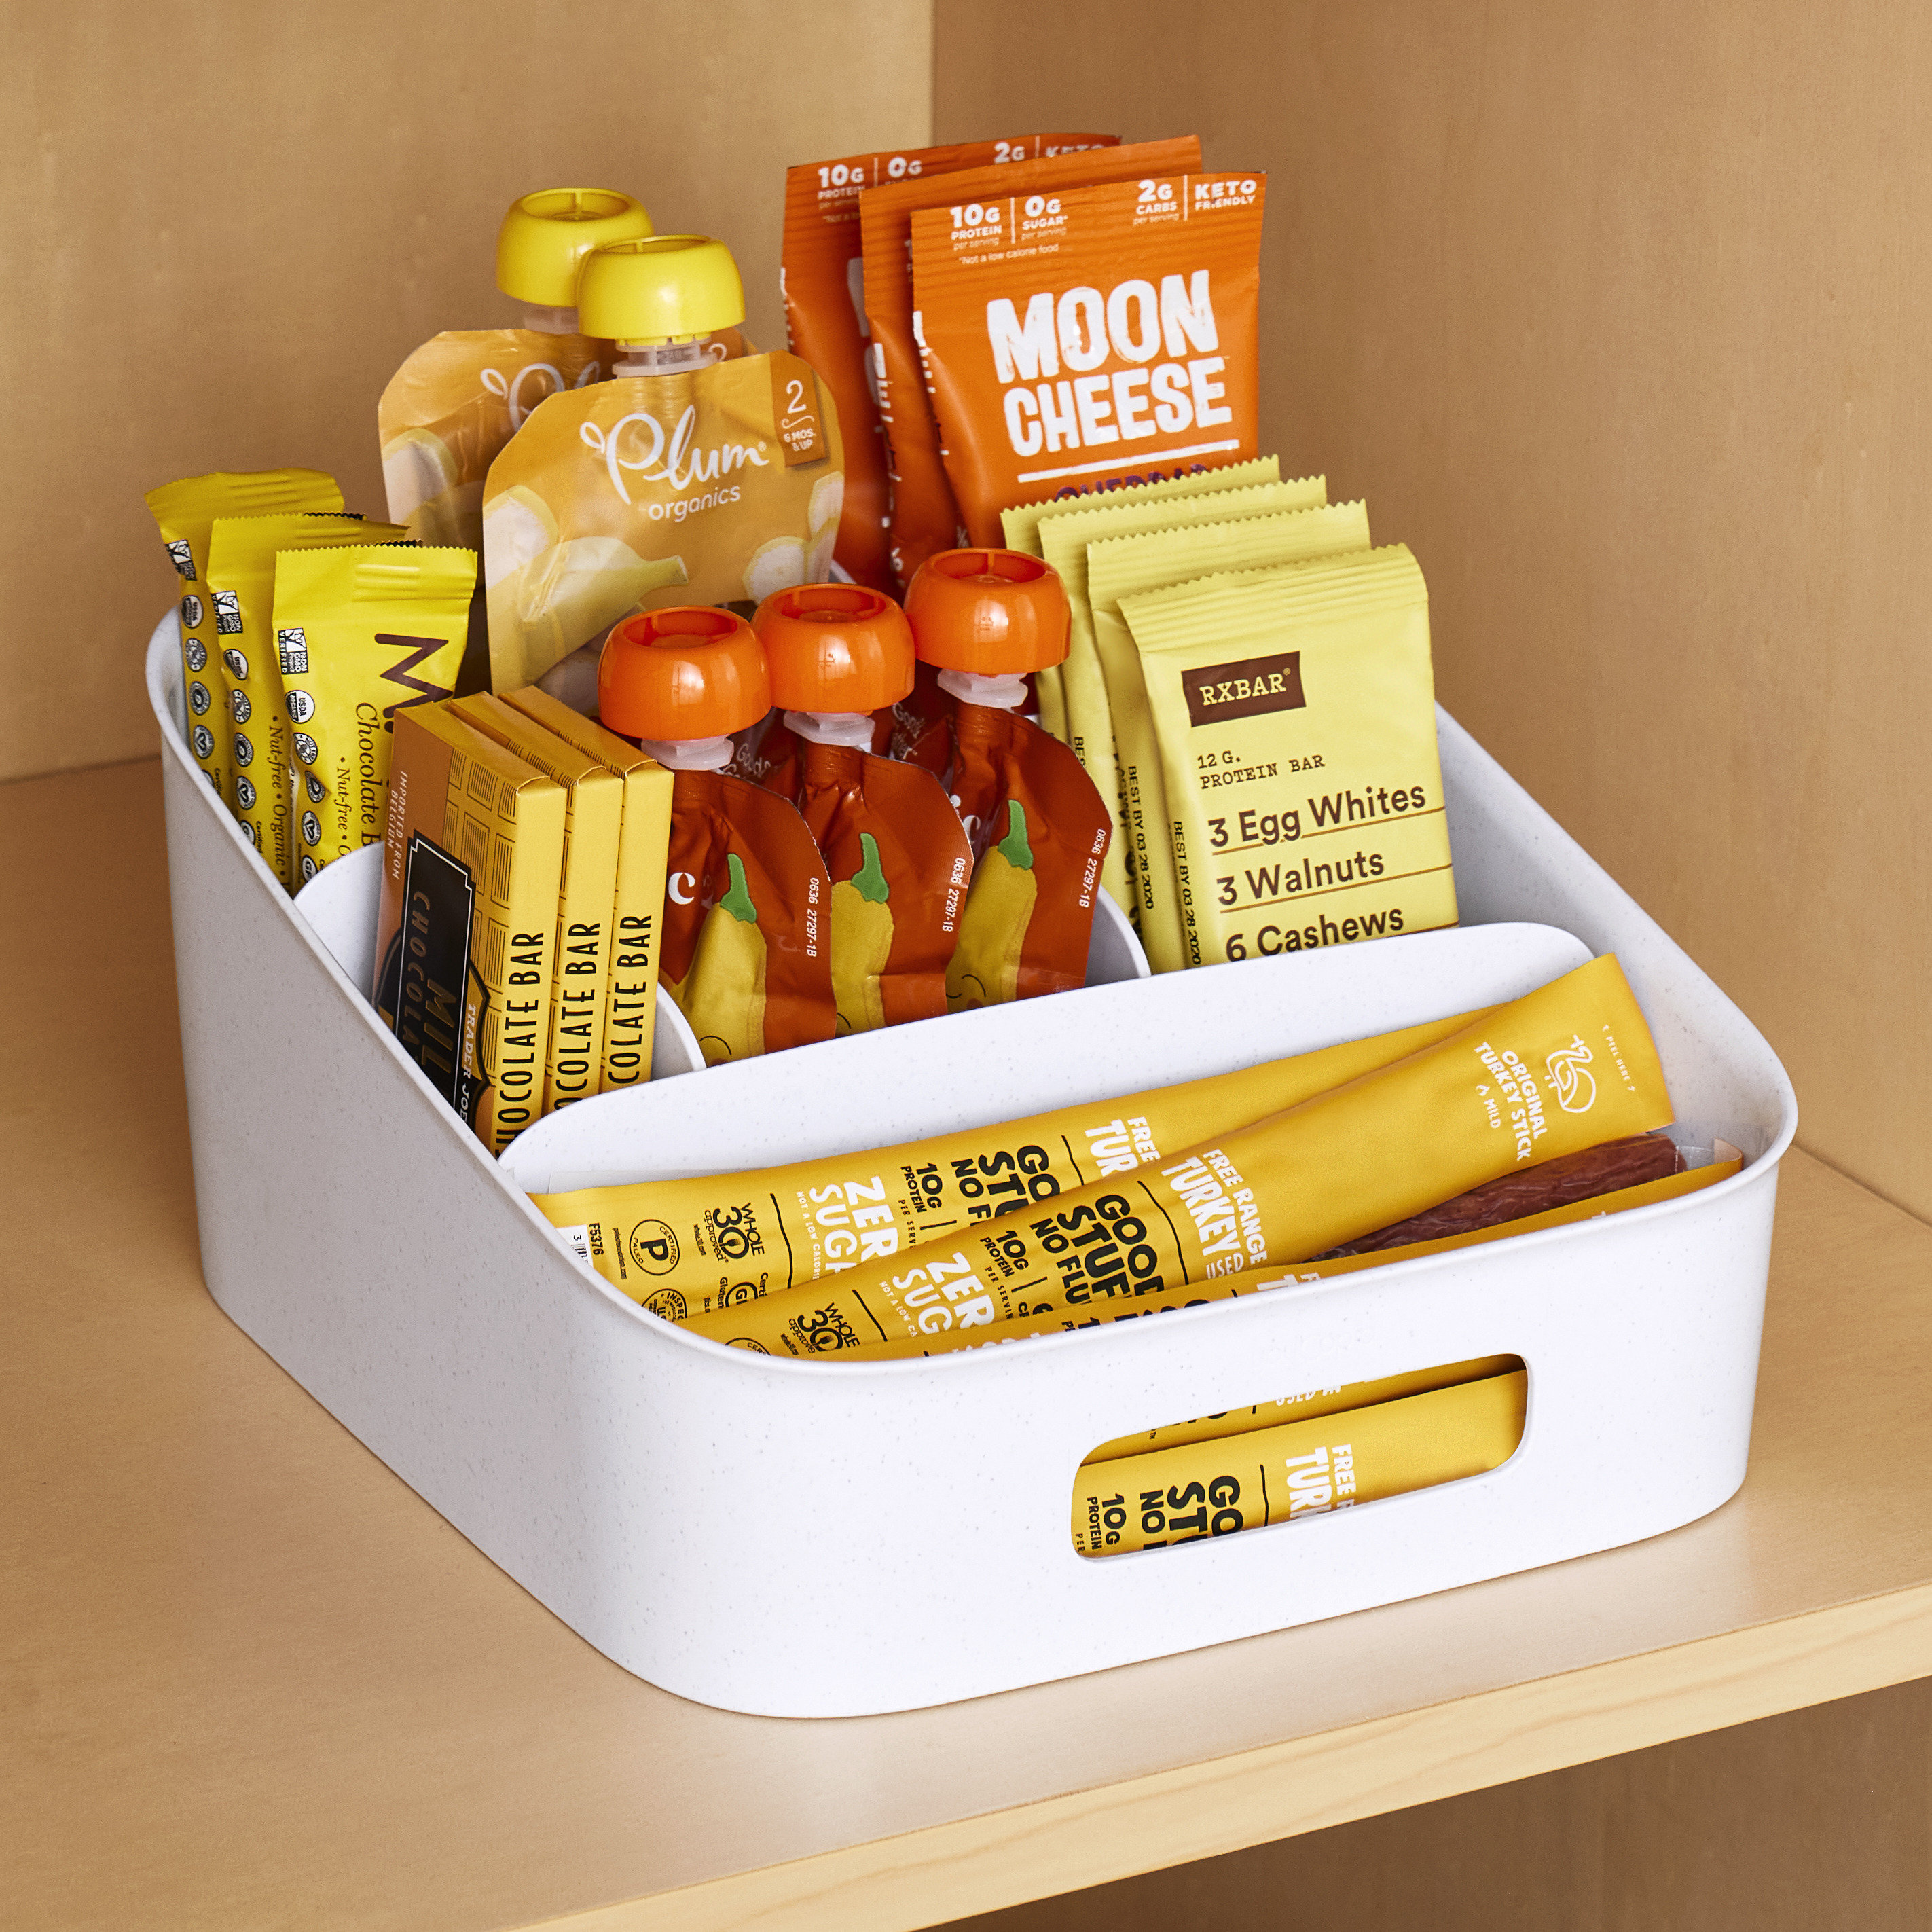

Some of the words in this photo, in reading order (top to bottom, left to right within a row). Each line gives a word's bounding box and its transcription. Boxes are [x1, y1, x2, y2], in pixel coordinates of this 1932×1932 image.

[818, 164, 864, 188] 10G
[888, 156, 922, 178] 0G
[994, 141, 1025, 164] 2G
[950, 204, 1000, 228] 10G
[1025, 196, 1061, 217] 0G
[1135, 201, 1178, 215] CARBS
[1137, 179, 1173, 202] 2G
[1195, 179, 1256, 200] KETO
[951, 225, 1002, 240] PROTEIN
[1006, 247, 1037, 259] calorie
[987, 270, 1218, 384] MOON
[786, 380, 807, 414] 2
[1004, 357, 1233, 457] CHEESE
[579, 405, 770, 505] Plum
[784, 433, 791, 443] 6
[799, 439, 813, 450] UP
[648, 485, 741, 523] organics
[1199, 673, 1286, 706] RXBAR
[267, 726, 286, 789] Nut-free
[356, 702, 384, 824] Chocolate
[1197, 753, 1217, 769] 12
[1223, 750, 1241, 765] G.
[1199, 763, 1278, 790] PROTEIN
[1289, 754, 1326, 772] BAR
[335, 767, 352, 831] Nut-free
[396, 771, 407, 838] IMPORTED
[1128, 766, 1141, 804] BEST
[270, 804, 289, 867] Organic
[386, 790, 398, 848] BELGIUM
[1133, 809, 1144, 829] BY
[1208, 818, 1229, 847] 3
[1239, 809, 1300, 845] Egg
[1308, 786, 1426, 828] Whites
[392, 842, 403, 880] FROM
[1091, 828, 1106, 854] 0636
[1136, 833, 1146, 851] 03
[1174, 821, 1188, 864] BEST
[1138, 854, 1149, 872] 28
[1179, 865, 1191, 887] BY
[1216, 876, 1237, 906] 3
[1245, 851, 1385, 900] Walnuts
[808, 877, 820, 905] 0636
[1142, 875, 1154, 909] 2020
[1183, 887, 1193, 906] 03
[1184, 909, 1197, 929] 28
[1226, 934, 1247, 962] 6
[1257, 908, 1404, 957] Cashews
[509, 932, 544, 985] BAR
[565, 923, 600, 974] BAR
[617, 915, 652, 967] BAR
[1188, 930, 1201, 965] 2020
[403, 891, 431, 1047] CHOCOLA
[421, 979, 456, 1074] MIL
[463, 1003, 476, 1079] TRADER
[608, 981, 646, 1084] COLATE
[495, 999, 539, 1153] HOCOLATE
[1501, 1050, 1548, 1140] ORIGINAL
[460, 1082, 469, 1125] JOE
[1474, 1042, 1523, 1104] TURKEY
[1511, 1108, 1531, 1161] STICK
[1484, 1098, 1501, 1129] MILD
[1127, 1116, 1161, 1162] FREE
[900, 1165, 927, 1213] PROTEIN
[916, 1163, 943, 1209] 10G
[951, 1159, 984, 1198] NO
[797, 1191, 808, 1209] NOT
[806, 1222, 818, 1239] LOW
[898, 1199, 910, 1216] PER
[1161, 1156, 1241, 1256] TURKEY
[1203, 1148, 1244, 1187] FREE
[1232, 1188, 1268, 1265] RANGE
[589, 1222, 604, 1256] F5376
[632, 1237, 644, 1264] PALEO
[640, 1239, 669, 1261] P
[659, 1226, 676, 1264] CERTIFIED
[713, 1206, 750, 1259] 30
[741, 1203, 765, 1256] WHOLE
[996, 1230, 1029, 1270] 10G
[980, 1237, 1015, 1277] PROTEIN
[1029, 1218, 1069, 1254] NO
[1056, 1255, 1092, 1305] FLU
[1057, 1205, 1132, 1298] STUF
[985, 1266, 999, 1283] PER
[879, 1281, 894, 1297] NOT
[896, 1306, 911, 1322] LOW
[797, 1309, 843, 1352] 30
[824, 1302, 860, 1347] WHOLE
[1286, 1446, 1332, 1518] TUR
[1332, 1444, 1357, 1495] FREE
[1087, 1496, 1103, 1550] PROTEIN
[1102, 1493, 1127, 1545] 10G
[1140, 1489, 1166, 1534] NO
[1075, 1533, 1085, 1552] PER
